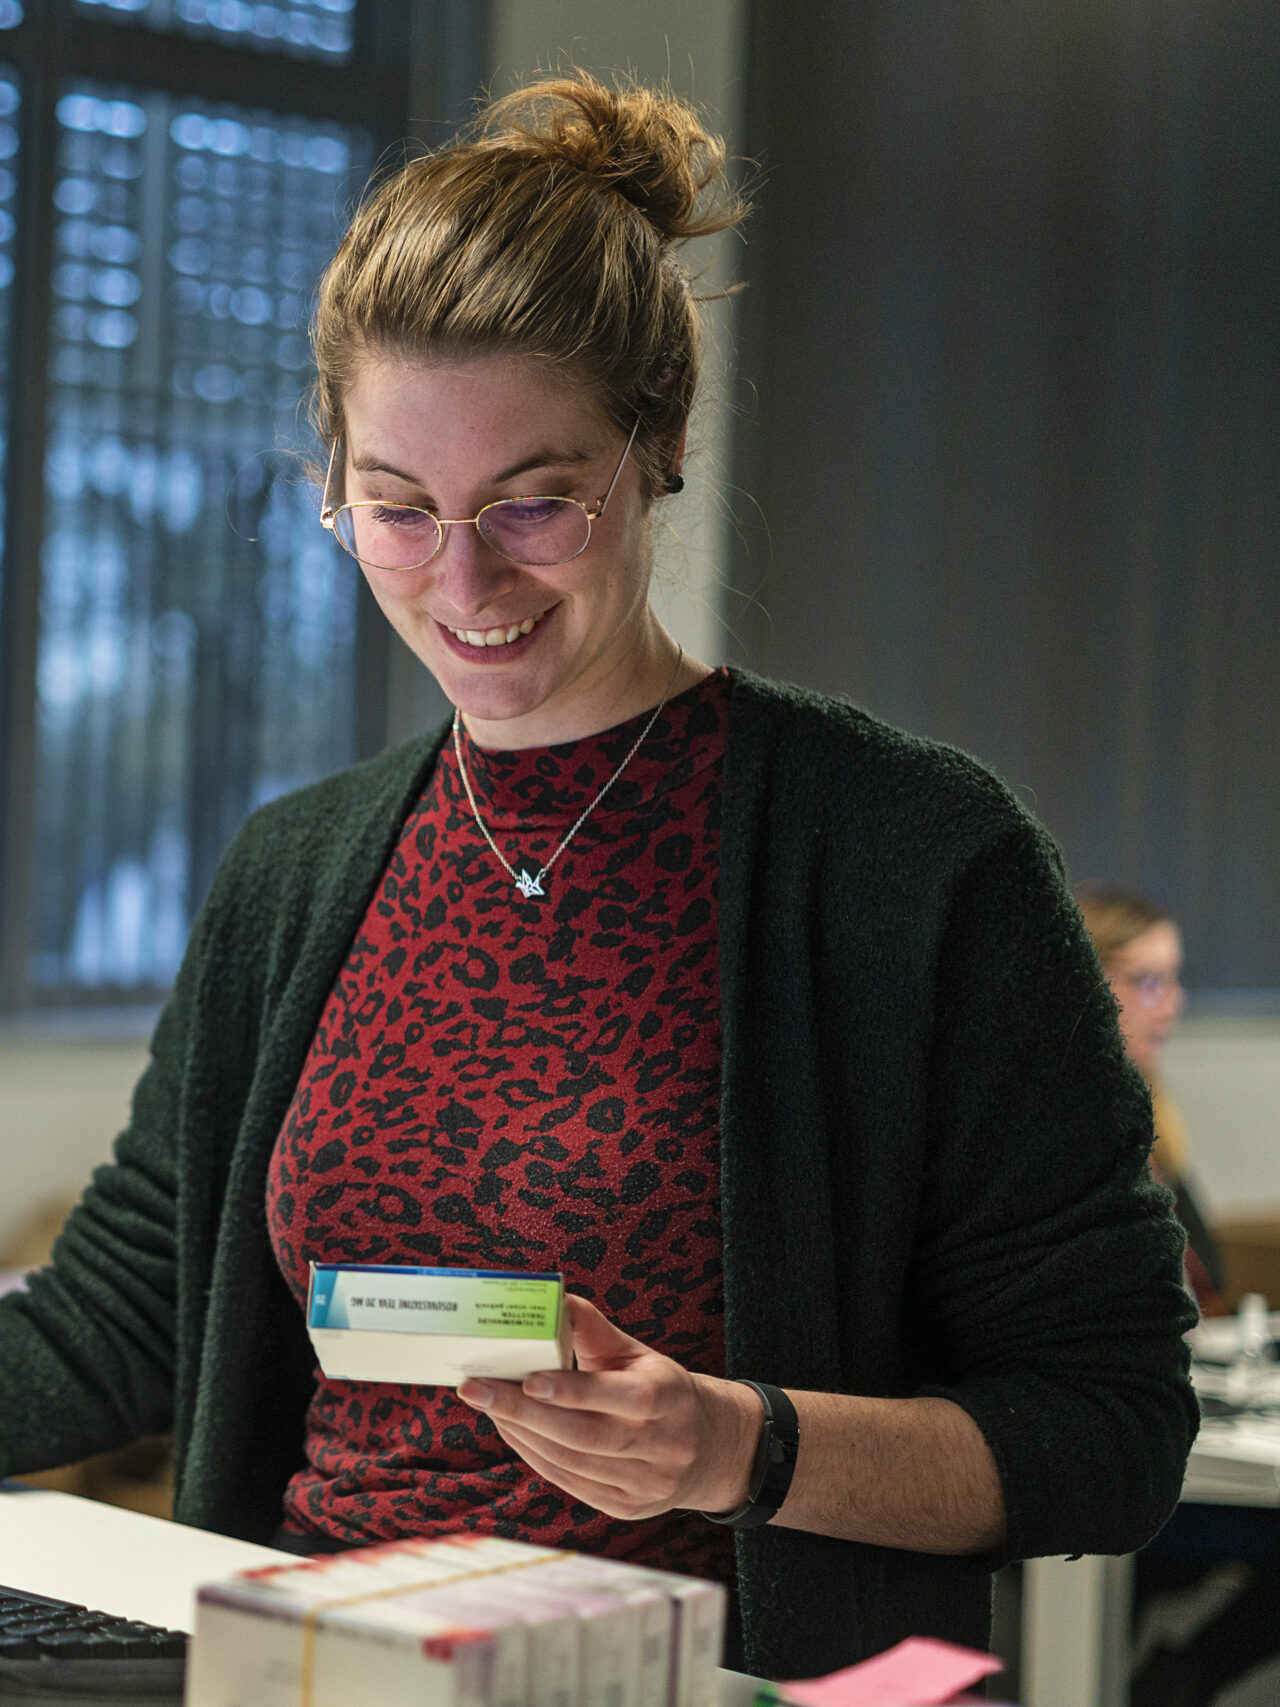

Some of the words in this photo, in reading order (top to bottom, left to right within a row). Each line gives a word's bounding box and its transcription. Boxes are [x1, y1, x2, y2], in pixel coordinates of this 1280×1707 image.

[350, 1296, 363, 1307] MG
[366, 1297, 376, 1308] 20
[378, 1297, 396, 1309] TEVA
[398, 1298, 458, 1312] ROSUVASTATINE
